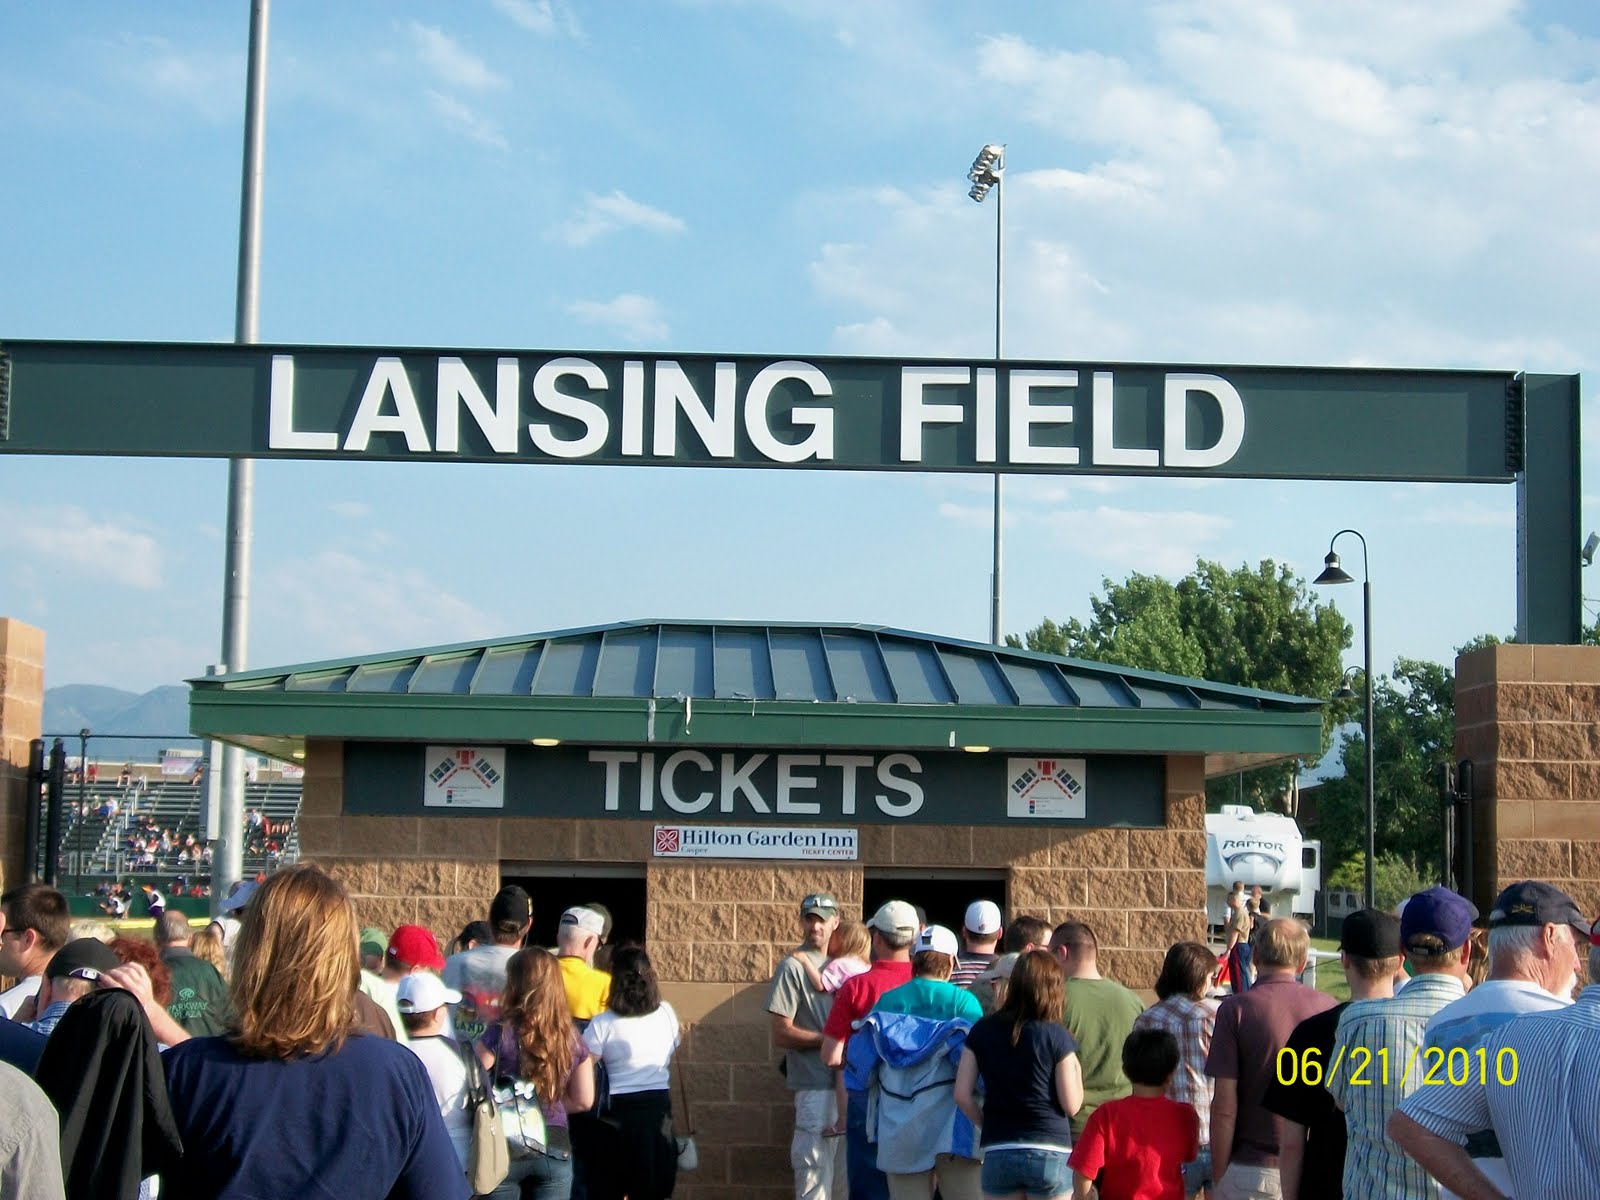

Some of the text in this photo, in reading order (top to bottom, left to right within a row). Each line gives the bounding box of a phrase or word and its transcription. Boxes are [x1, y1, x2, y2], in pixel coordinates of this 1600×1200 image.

[268, 354, 1246, 468] LANSING FIELD
[588, 750, 925, 818] TICKETS
[683, 830, 853, 848] Hilton Garden Inn
[1222, 840, 1285, 853] RAPTOR
[681, 846, 708, 855] Casper
[166, 1001, 208, 1014] PARKWAY
